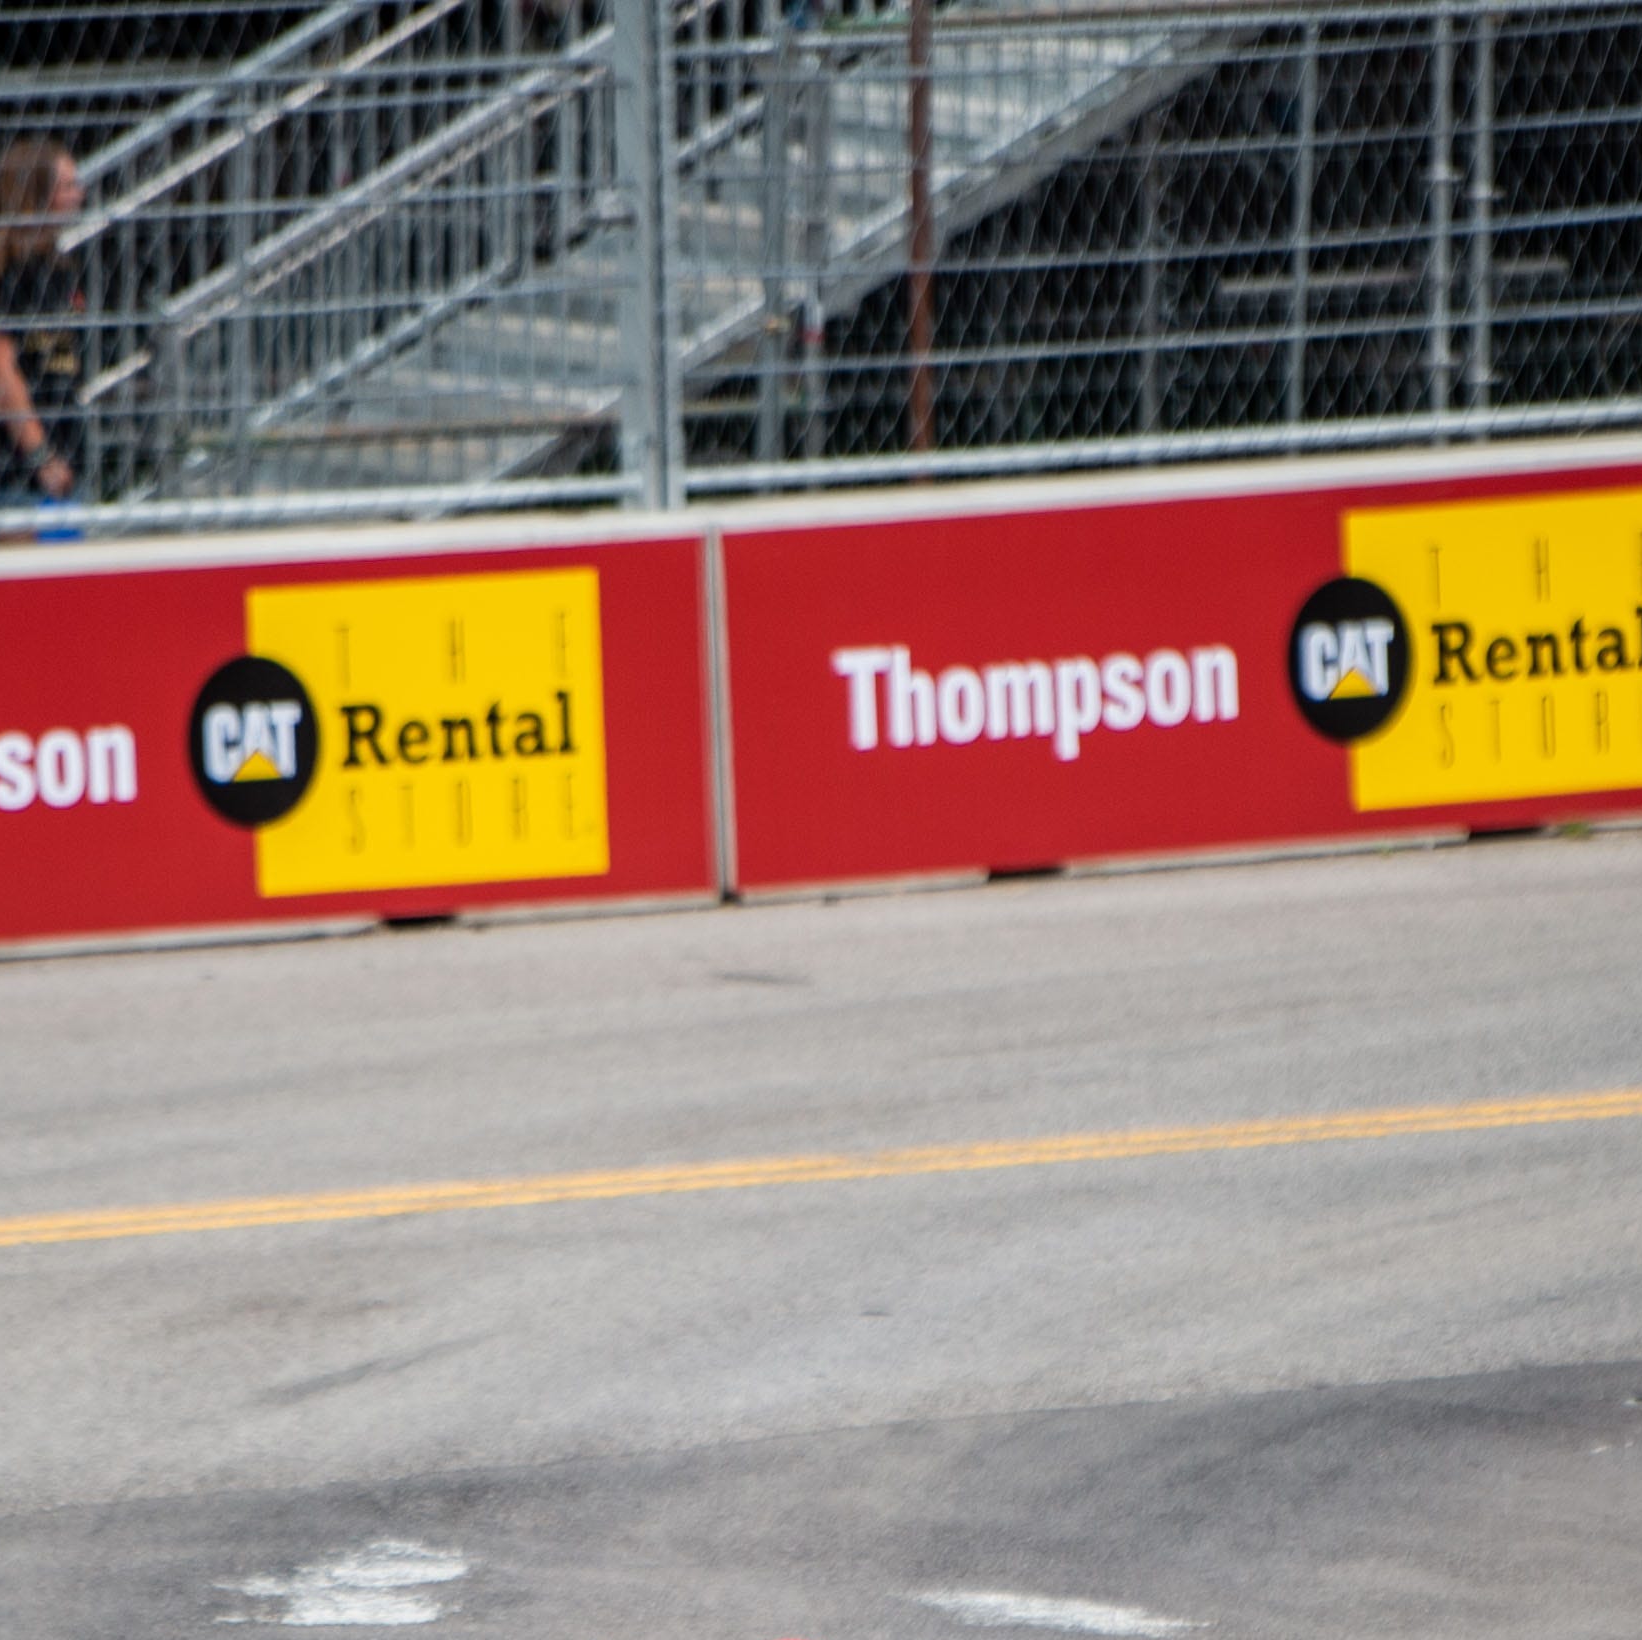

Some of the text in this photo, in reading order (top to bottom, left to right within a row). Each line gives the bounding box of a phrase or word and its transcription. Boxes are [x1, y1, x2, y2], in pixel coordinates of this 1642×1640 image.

[1299, 618, 1394, 699] CAT
[202, 700, 302, 783] CAT
[338, 690, 578, 771] Rental
[833, 643, 1240, 761] Thompson
